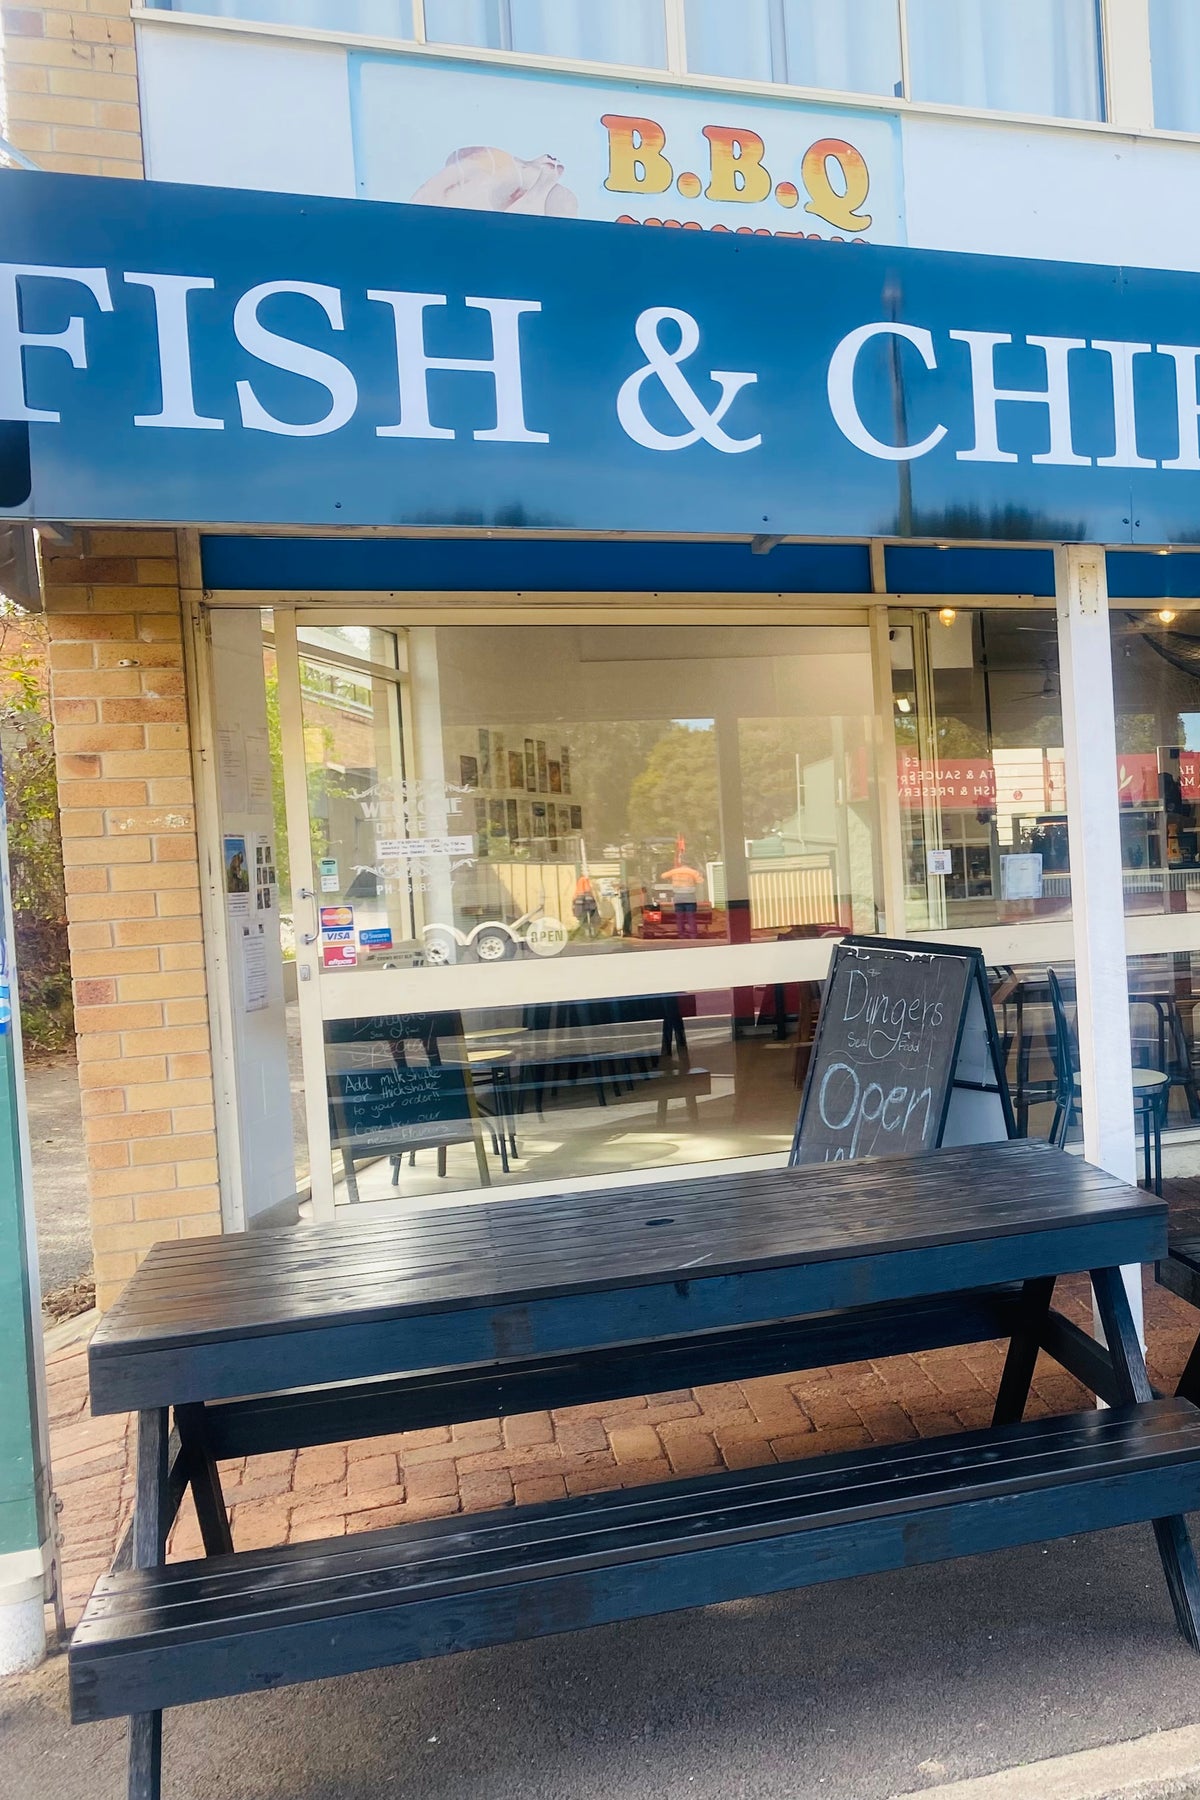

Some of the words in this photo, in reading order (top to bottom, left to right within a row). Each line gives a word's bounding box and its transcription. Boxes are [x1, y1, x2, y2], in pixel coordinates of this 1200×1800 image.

[600, 114, 872, 232] B.B.Q
[0, 262, 550, 445] FISH
[616, 306, 763, 454] &
[327, 932, 351, 941] VISA
[843, 969, 944, 1060] Dingers
[345, 1075, 373, 1094] Add
[353, 1093, 371, 1103] or
[353, 1104, 365, 1116] to
[371, 1100, 397, 1119] your
[819, 1062, 933, 1159] Open
